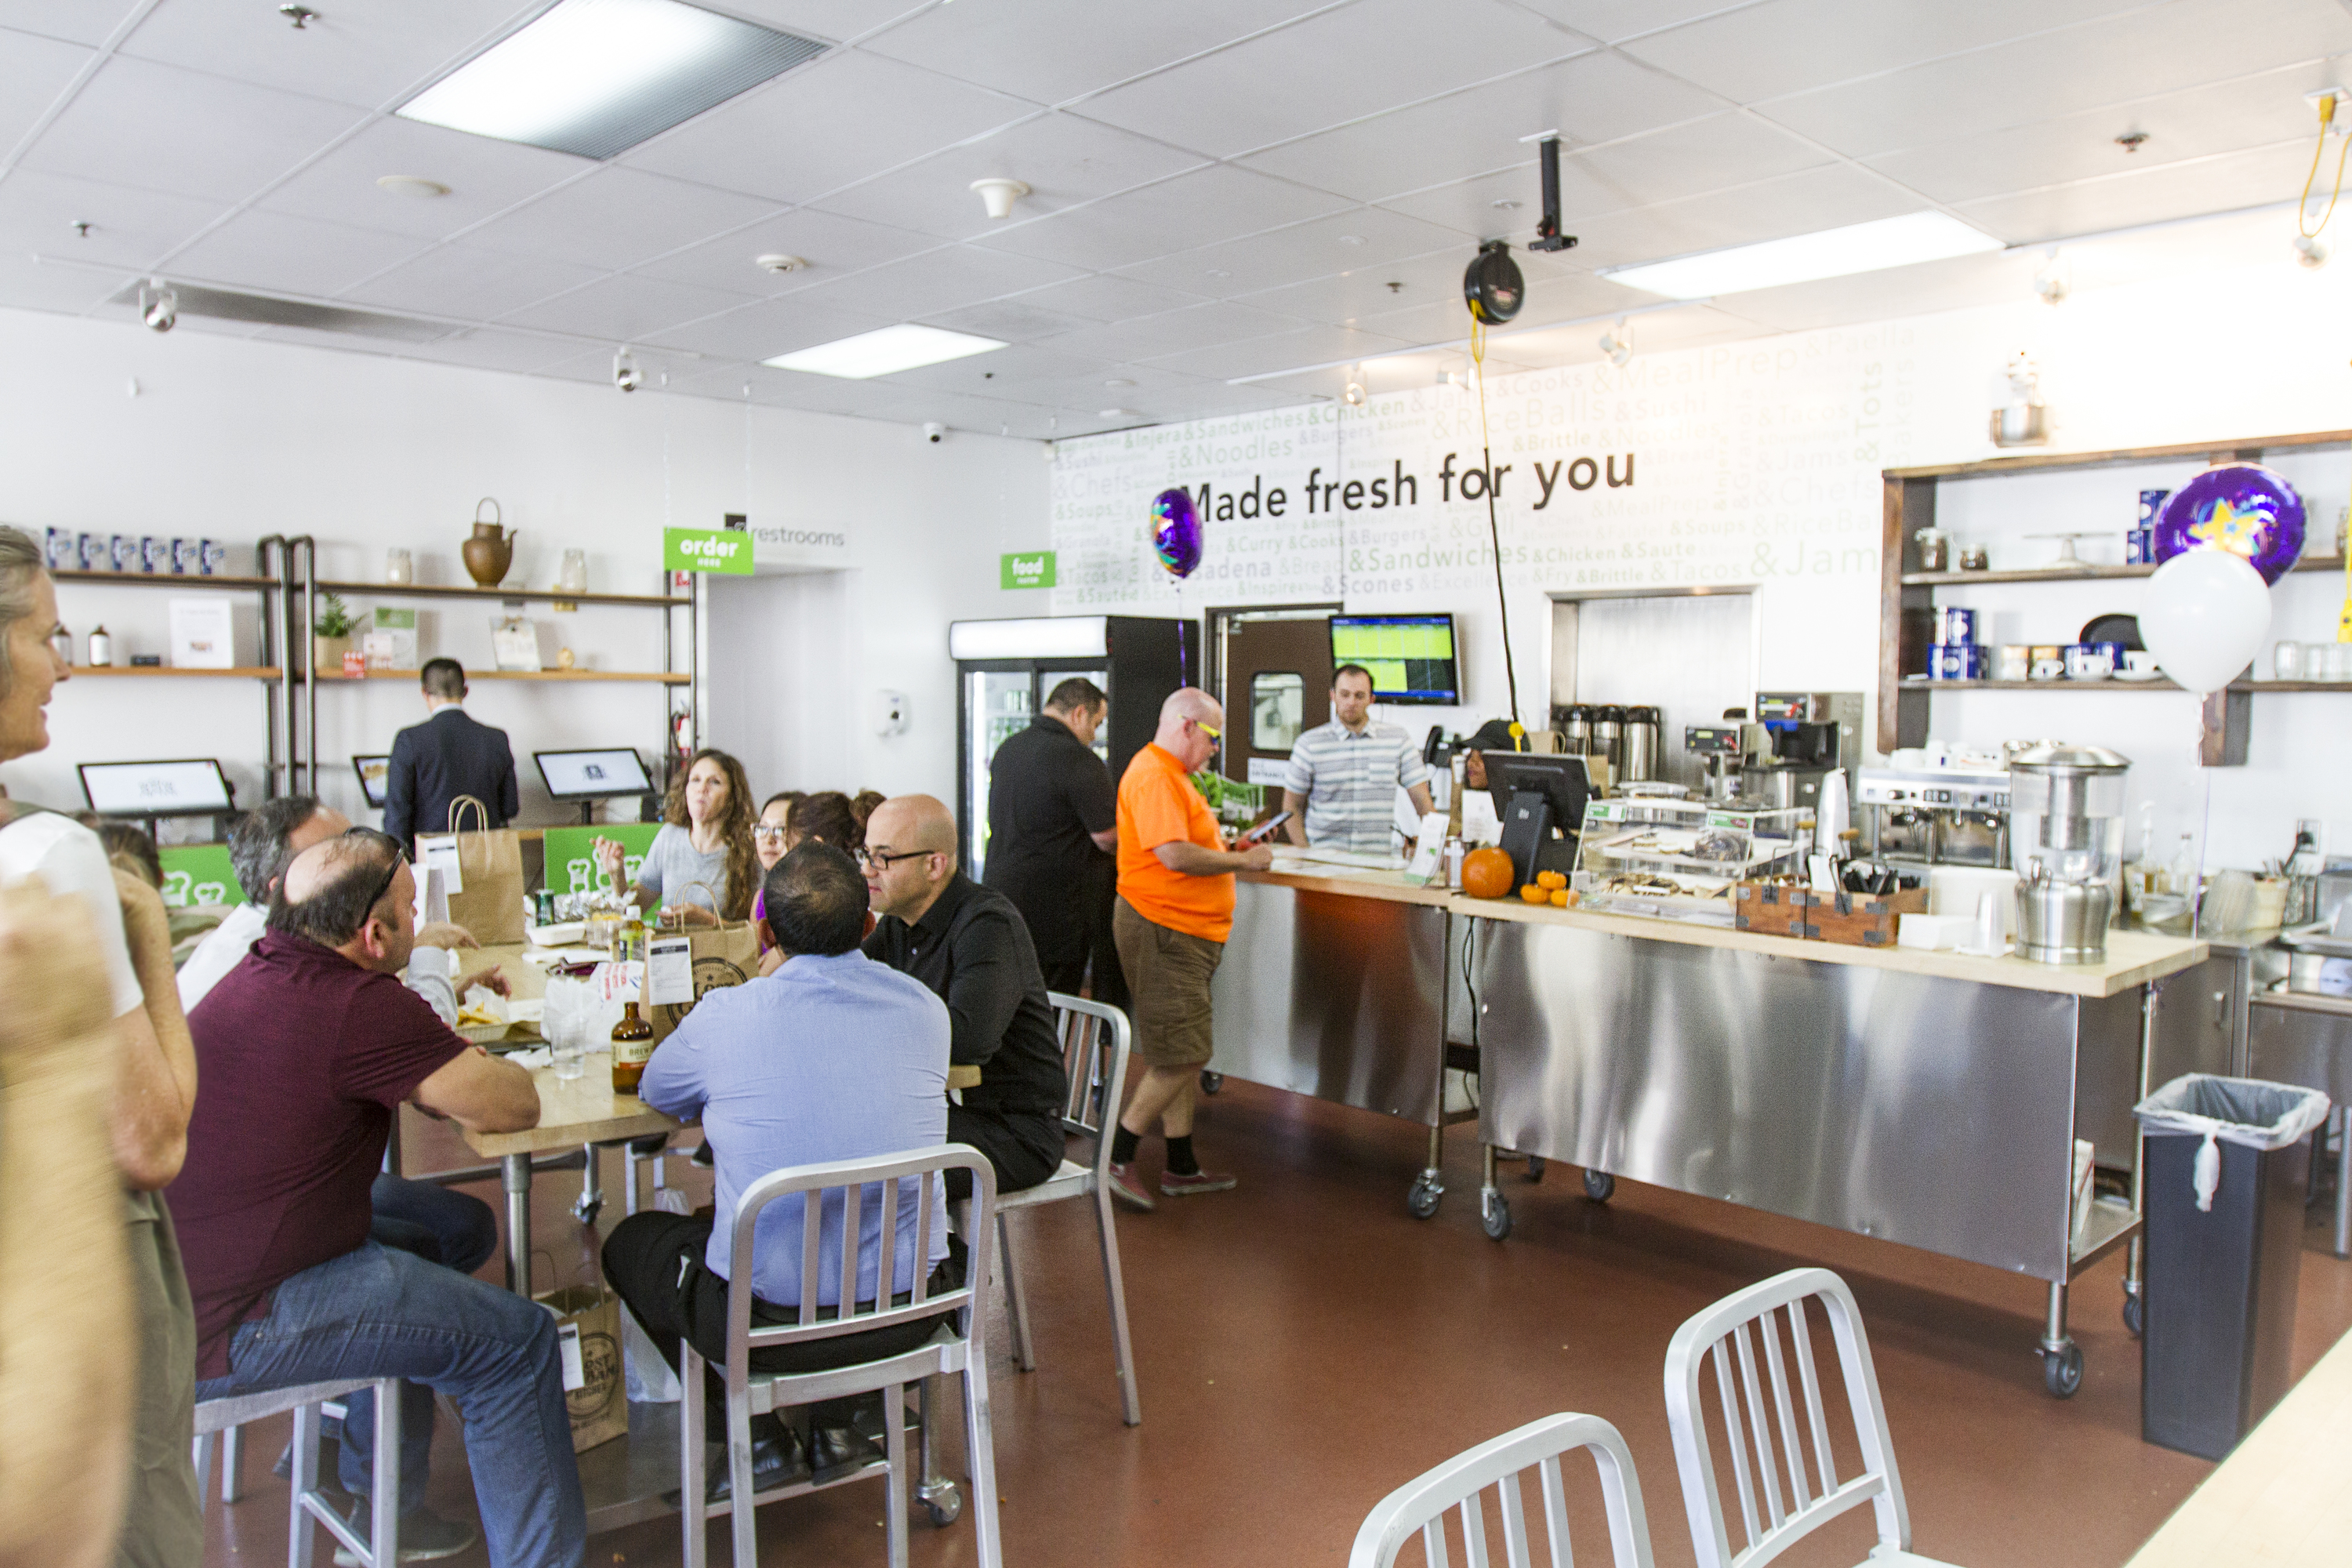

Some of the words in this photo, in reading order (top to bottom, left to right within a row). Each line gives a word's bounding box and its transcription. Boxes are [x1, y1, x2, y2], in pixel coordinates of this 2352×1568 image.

[1805, 323, 1914, 358] &Paella
[1497, 370, 1583, 397] &Cooks
[1592, 347, 1798, 394] &MealPrep
[1614, 390, 1707, 422] &Sushi
[1757, 403, 1849, 427] &Tacos
[1853, 361, 1882, 463] &Tots
[1886, 358, 1915, 468] Bakers
[1184, 405, 1303, 441] &Sandwiches
[1597, 419, 1721, 448] &Noodles
[1179, 434, 1294, 469] &Noodles
[1512, 429, 1591, 452] &Brittle
[1642, 442, 1715, 466] &Bread
[1733, 388, 1753, 510] &Granola
[1166, 449, 1176, 483] Deli
[1713, 434, 1731, 510] &Injera
[1755, 449, 1847, 473] &Jams
[1053, 466, 1131, 500] &Chefs
[1179, 474, 1288, 523] Made
[1304, 458, 1417, 515] fresh
[1437, 451, 1513, 503] for
[1532, 452, 1635, 512] you
[1755, 472, 1878, 508] &Chefs
[1055, 502, 1112, 521] &Soups
[1591, 493, 1708, 519] &MealPrep
[1449, 512, 1514, 539] &Grll
[1670, 518, 1746, 536] &Soups
[1752, 508, 1881, 536] &RiceBal
[680, 535, 739, 558] order
[753, 525, 845, 547] restrooms
[1227, 535, 1283, 554] &Curry
[1349, 527, 1427, 546] &Burgers
[1012, 555, 1044, 576] food
[1348, 539, 1527, 573] &Sandwiches
[1533, 546, 1616, 564] &Chicken
[1750, 539, 1878, 577] &Jam
[1151, 555, 1271, 583] &sadena
[1420, 569, 1527, 590] &Excellece
[1533, 567, 1572, 586] &Fry
[1577, 568, 1644, 584] &Brittle
[1650, 557, 1742, 582] &Tacos
